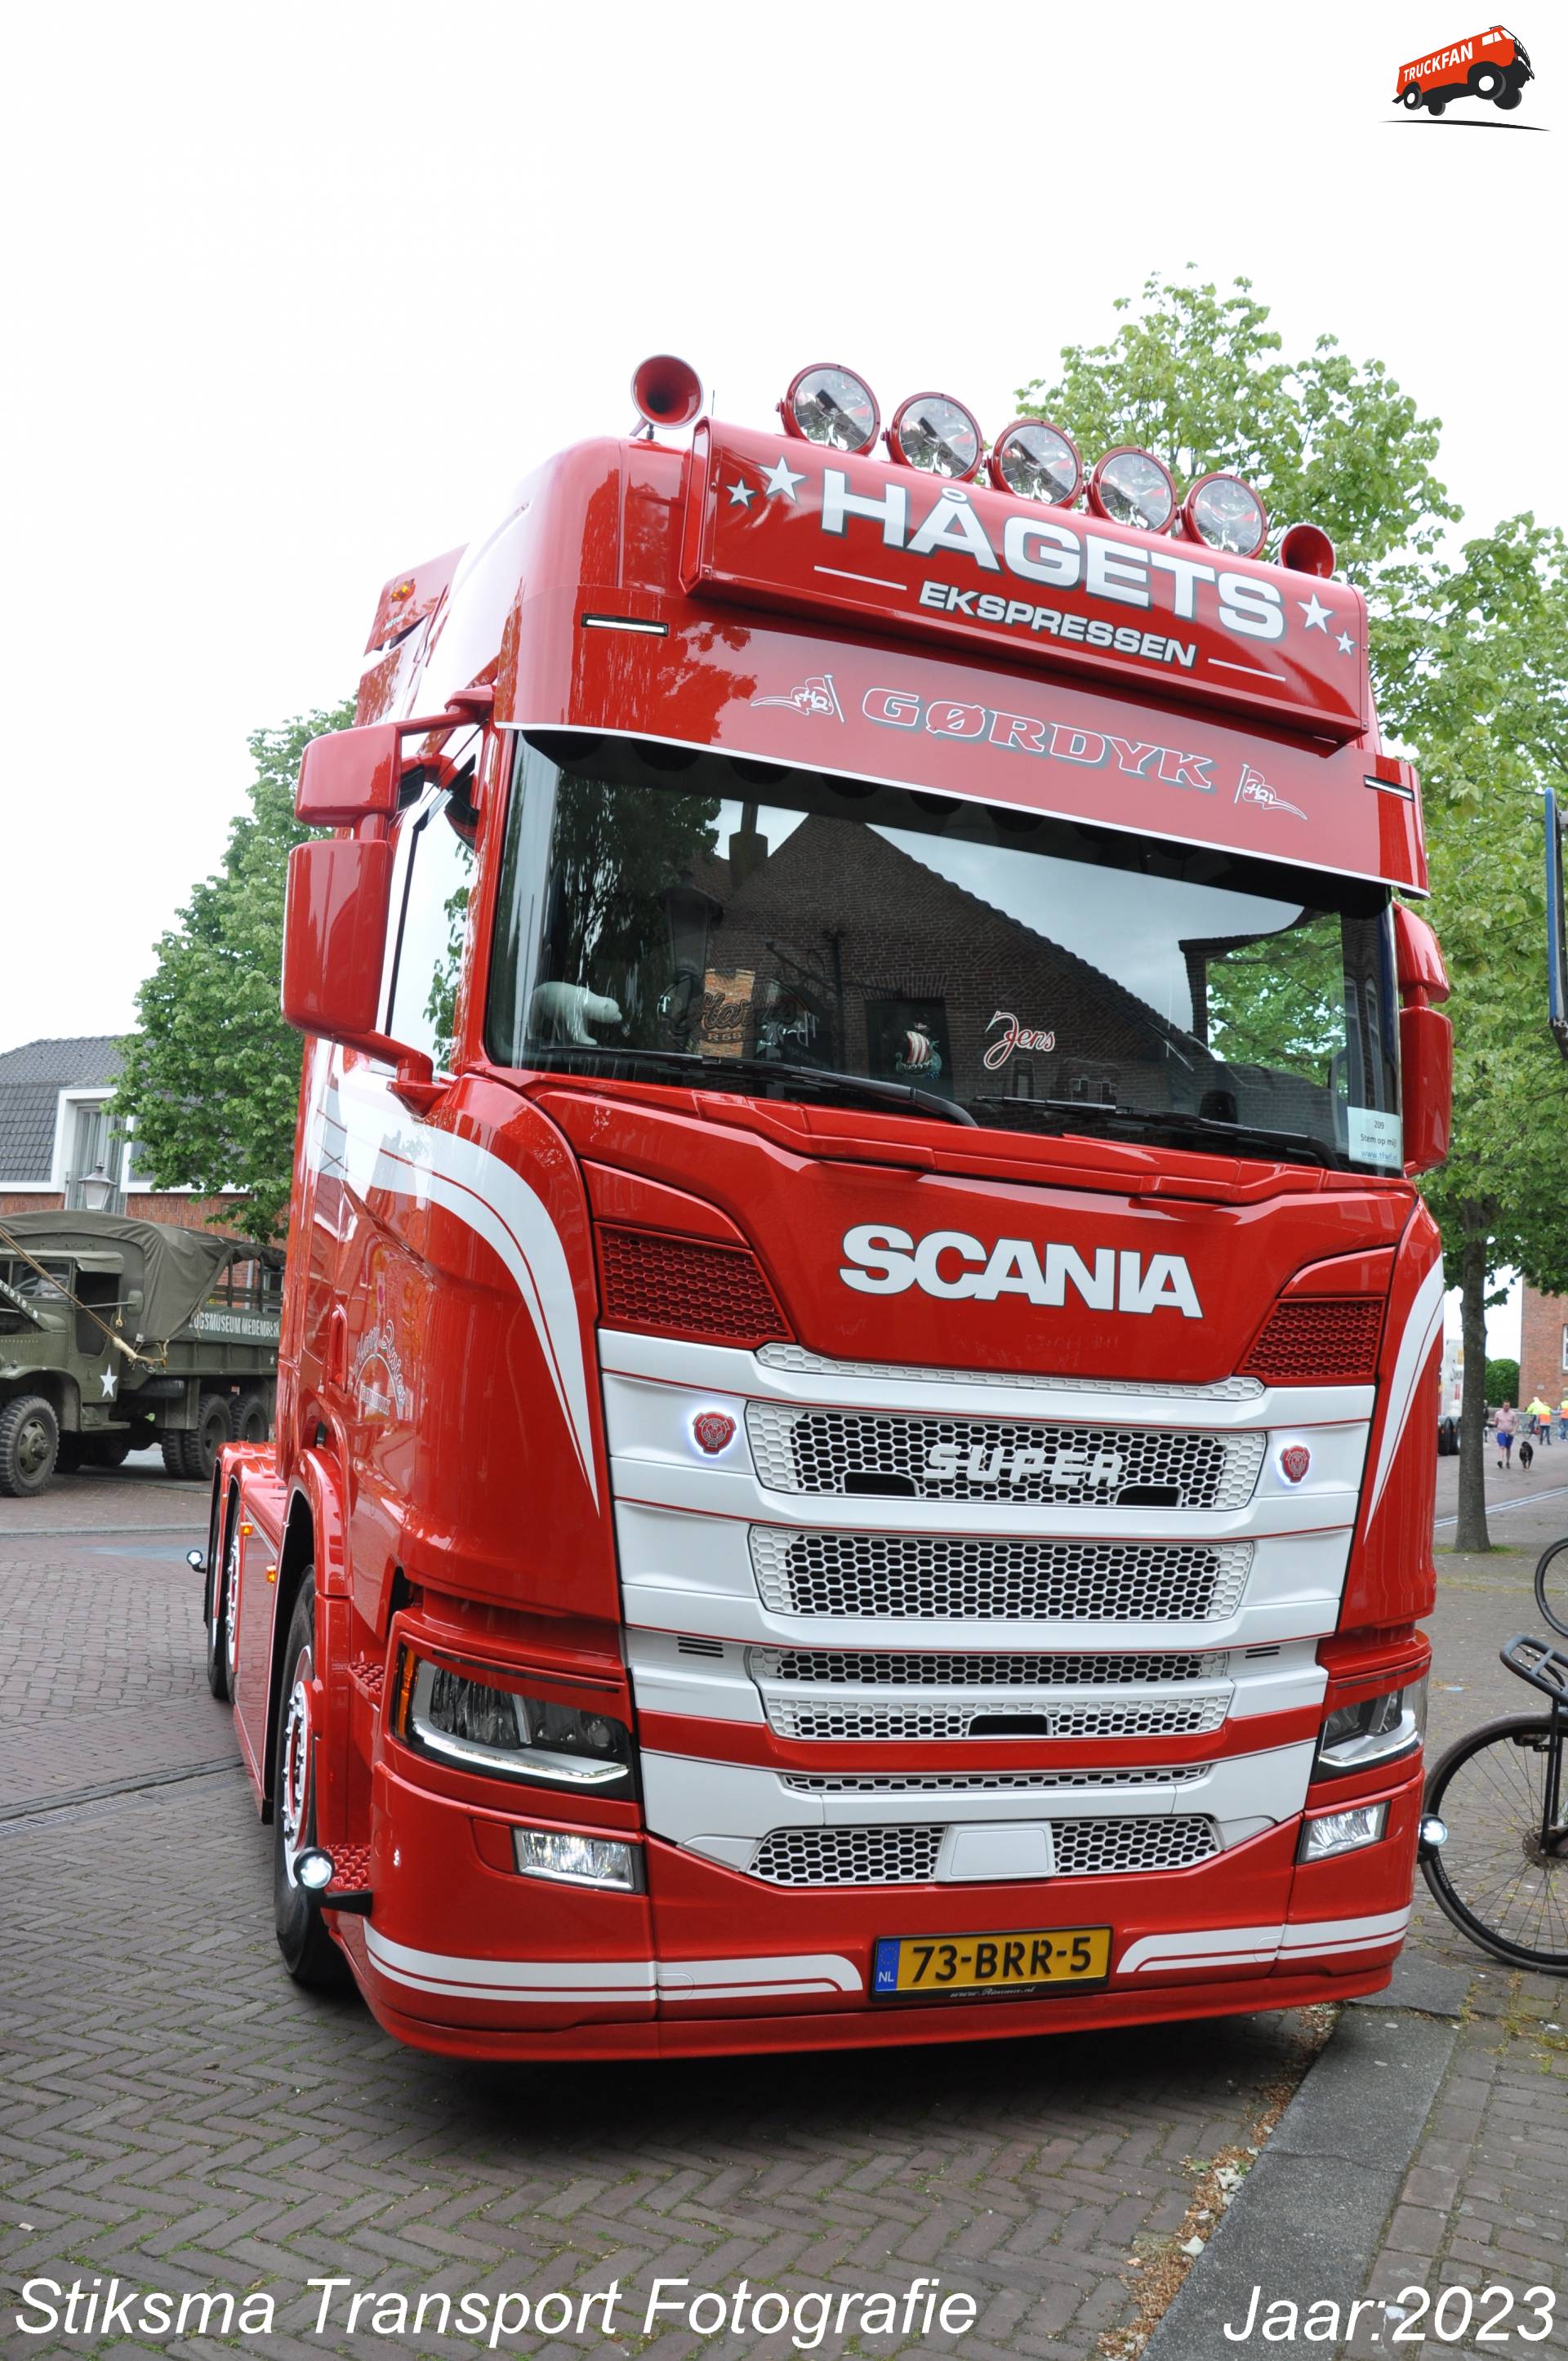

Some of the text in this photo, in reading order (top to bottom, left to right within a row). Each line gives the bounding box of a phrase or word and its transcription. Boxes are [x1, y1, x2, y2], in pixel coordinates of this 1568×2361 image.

[820, 467, 1286, 642] HÅGETS
[918, 581, 1198, 669] EKSPRESSEN
[861, 686, 1217, 792] GØRDYK
[984, 1011, 1055, 1070] Jens
[1360, 1133, 1376, 1143] Stem
[1377, 1138, 1386, 1147] op
[839, 1223, 1204, 1319] SCANIA
[923, 1444, 1124, 1487] SUPER
[878, 1936, 1091, 1983] NL 73-BRR-5
